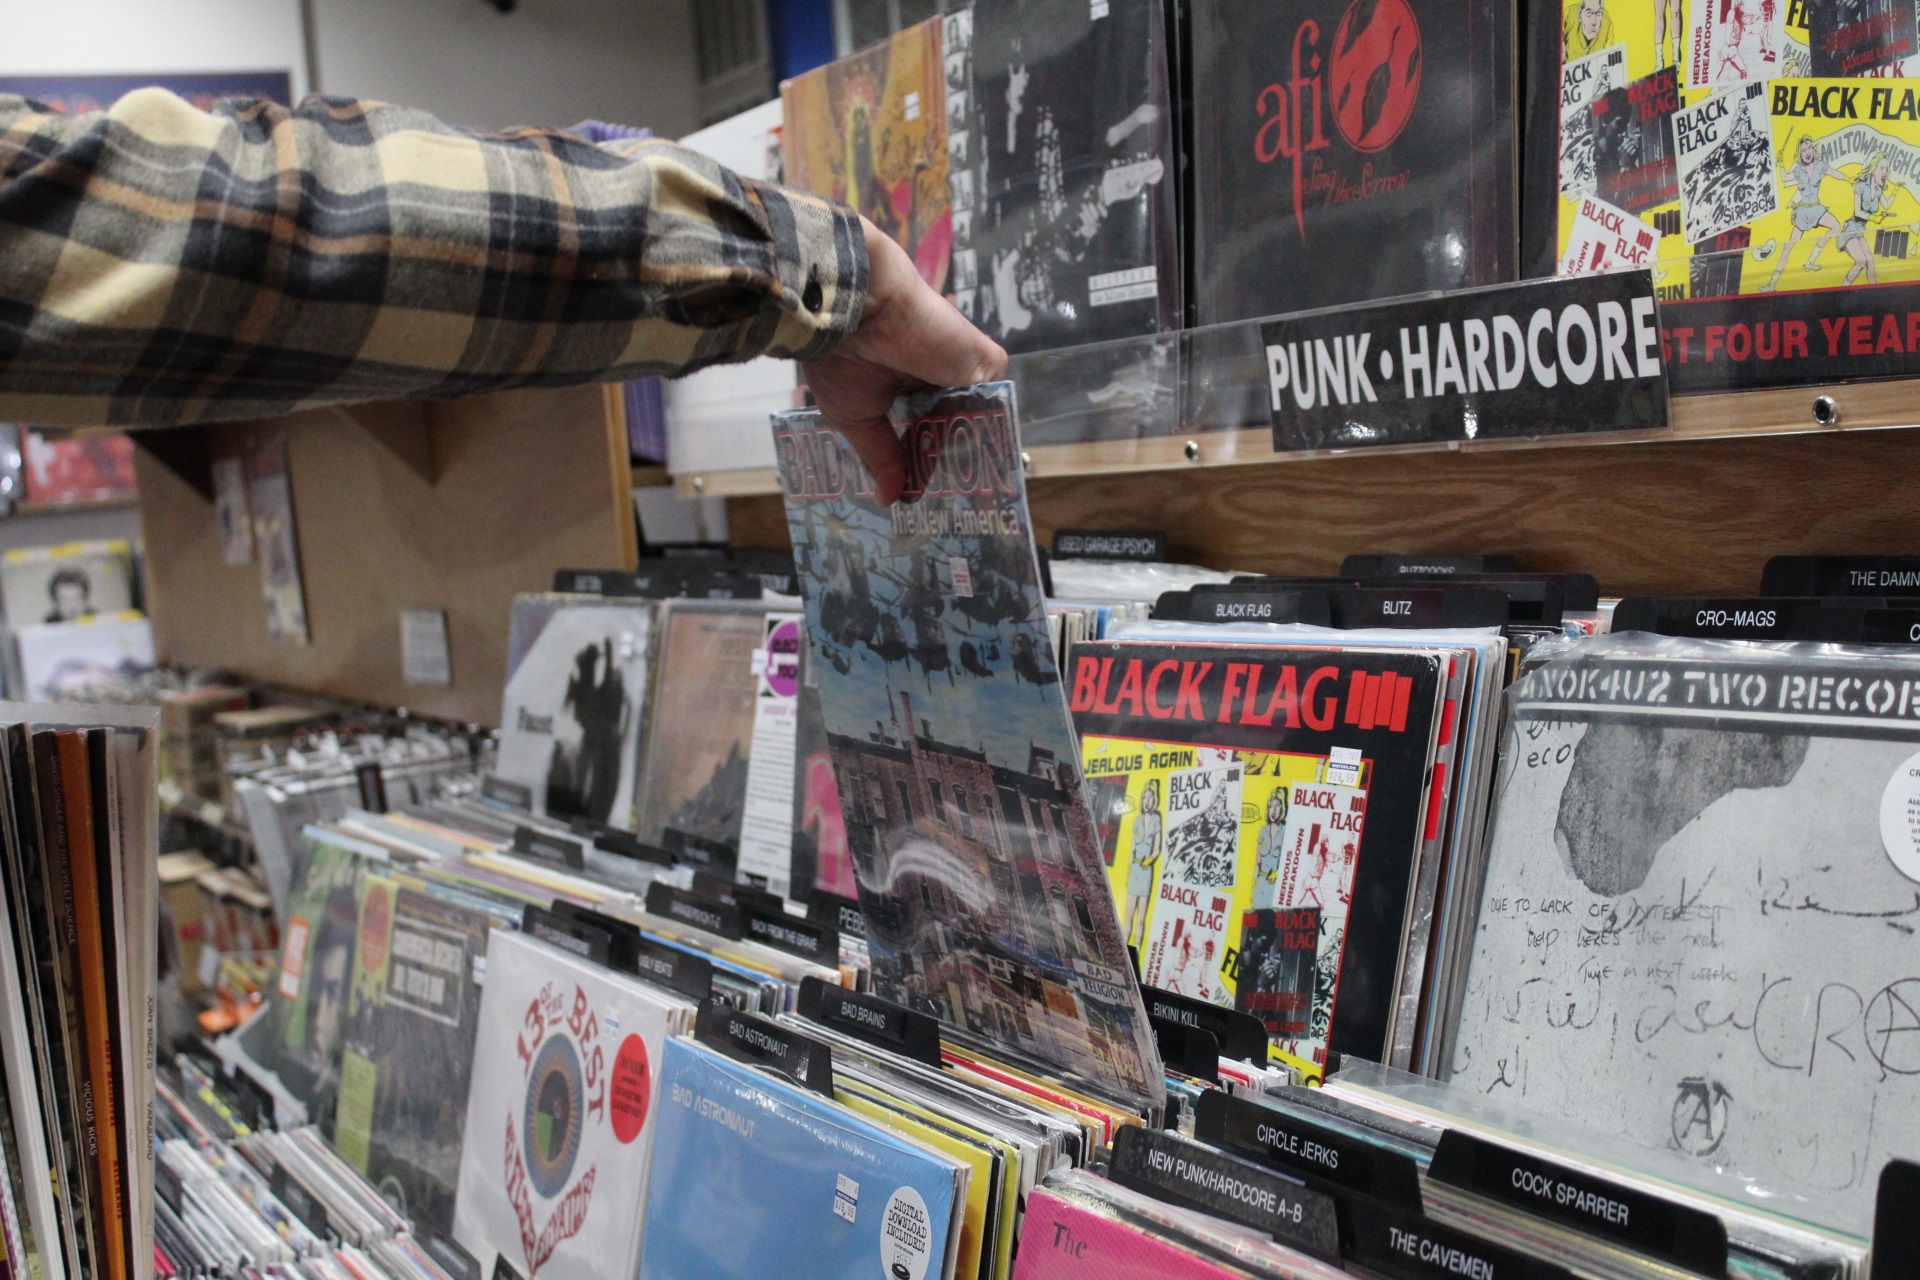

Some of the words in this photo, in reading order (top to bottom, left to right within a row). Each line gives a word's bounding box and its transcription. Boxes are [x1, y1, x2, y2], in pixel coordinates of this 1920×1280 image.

[1692, 25, 1703, 86] NERVOUS
[1702, 0, 1714, 84] BREAKDOWN
[1627, 71, 1675, 105] BLACK
[1771, 85, 1861, 119] BLACK
[1868, 87, 1920, 121] FLA
[1640, 93, 1677, 122] FLAG
[1676, 96, 1730, 136] BLACK
[1255, 19, 1332, 243] afi
[1678, 122, 1718, 156] FLAG
[1582, 199, 1625, 236] BLACK
[1723, 204, 1742, 225] Six
[1744, 194, 1774, 217] Pack
[1614, 237, 1649, 265] FLAG
[1266, 332, 1378, 412] PUNK
[1400, 296, 1661, 399] HARDCORE
[1704, 319, 1809, 363] FOUR
[916, 503, 951, 537] New
[953, 500, 1021, 537] America
[1850, 571, 1877, 586] THE
[1216, 603, 1246, 617] BLACK
[1246, 604, 1272, 618] FLAG
[1382, 600, 1413, 615] BLITZ
[1695, 610, 1777, 627] CRO-MAGS
[1070, 656, 1214, 722] BLACK
[1216, 662, 1340, 732] FLAG
[1683, 670, 1767, 706] TWO
[1084, 754, 1144, 775] JEALOUS
[1149, 750, 1194, 769] AGAIN
[1170, 772, 1212, 794] BLACK
[1293, 788, 1337, 810] BLACK
[1169, 791, 1201, 812] FLAG
[1278, 850, 1293, 906] NERVOUS
[1286, 828, 1305, 907] BREAKDOWN
[1160, 883, 1200, 908] BLACK
[1490, 898, 1508, 912] DUE
[1515, 898, 1531, 912] TO
[1540, 898, 1574, 914] LACK
[1588, 903, 1610, 917] OF
[65, 900, 77, 946] SCIENCE
[1193, 909, 1223, 932] FLAG
[1274, 911, 1319, 930] BLACK
[1284, 931, 1316, 949] FLAG
[1085, 963, 1113, 981] BAD
[1083, 979, 1126, 1001] RELIGION
[840, 1000, 859, 1021] BAD
[857, 1006, 886, 1031] BRAINS
[1153, 1002, 1180, 1023] BIKINI
[1181, 1010, 1200, 1029] KILL
[729, 1019, 745, 1040] BAD
[743, 1026, 789, 1059] ASTRONAUT
[84, 1080, 96, 1123] VICIOUS
[672, 1083, 693, 1108] BAD
[693, 1094, 757, 1139] ASTRONAUT
[87, 1126, 99, 1157] KICKS
[146, 1101, 156, 1162] VANGUARD
[1257, 1124, 1298, 1155] CIRCLE
[1299, 1140, 1339, 1169] JERKS
[1147, 1148, 1175, 1173] NEW
[1175, 1158, 1277, 1216] PUNK/HARDCORE
[1277, 1198, 1303, 1224] A-B
[1511, 1167, 1553, 1199] COCK
[1555, 1182, 1630, 1227] SPARRER
[887, 1209, 927, 1239] DOWNLOAD
[893, 1198, 924, 1224] DIGITAL
[886, 1223, 926, 1254] INCLUDED!
[1053, 1221, 1088, 1260] The
[1389, 1226, 1416, 1256] THE
[1419, 1238, 1494, 1280] CAVEMEN
